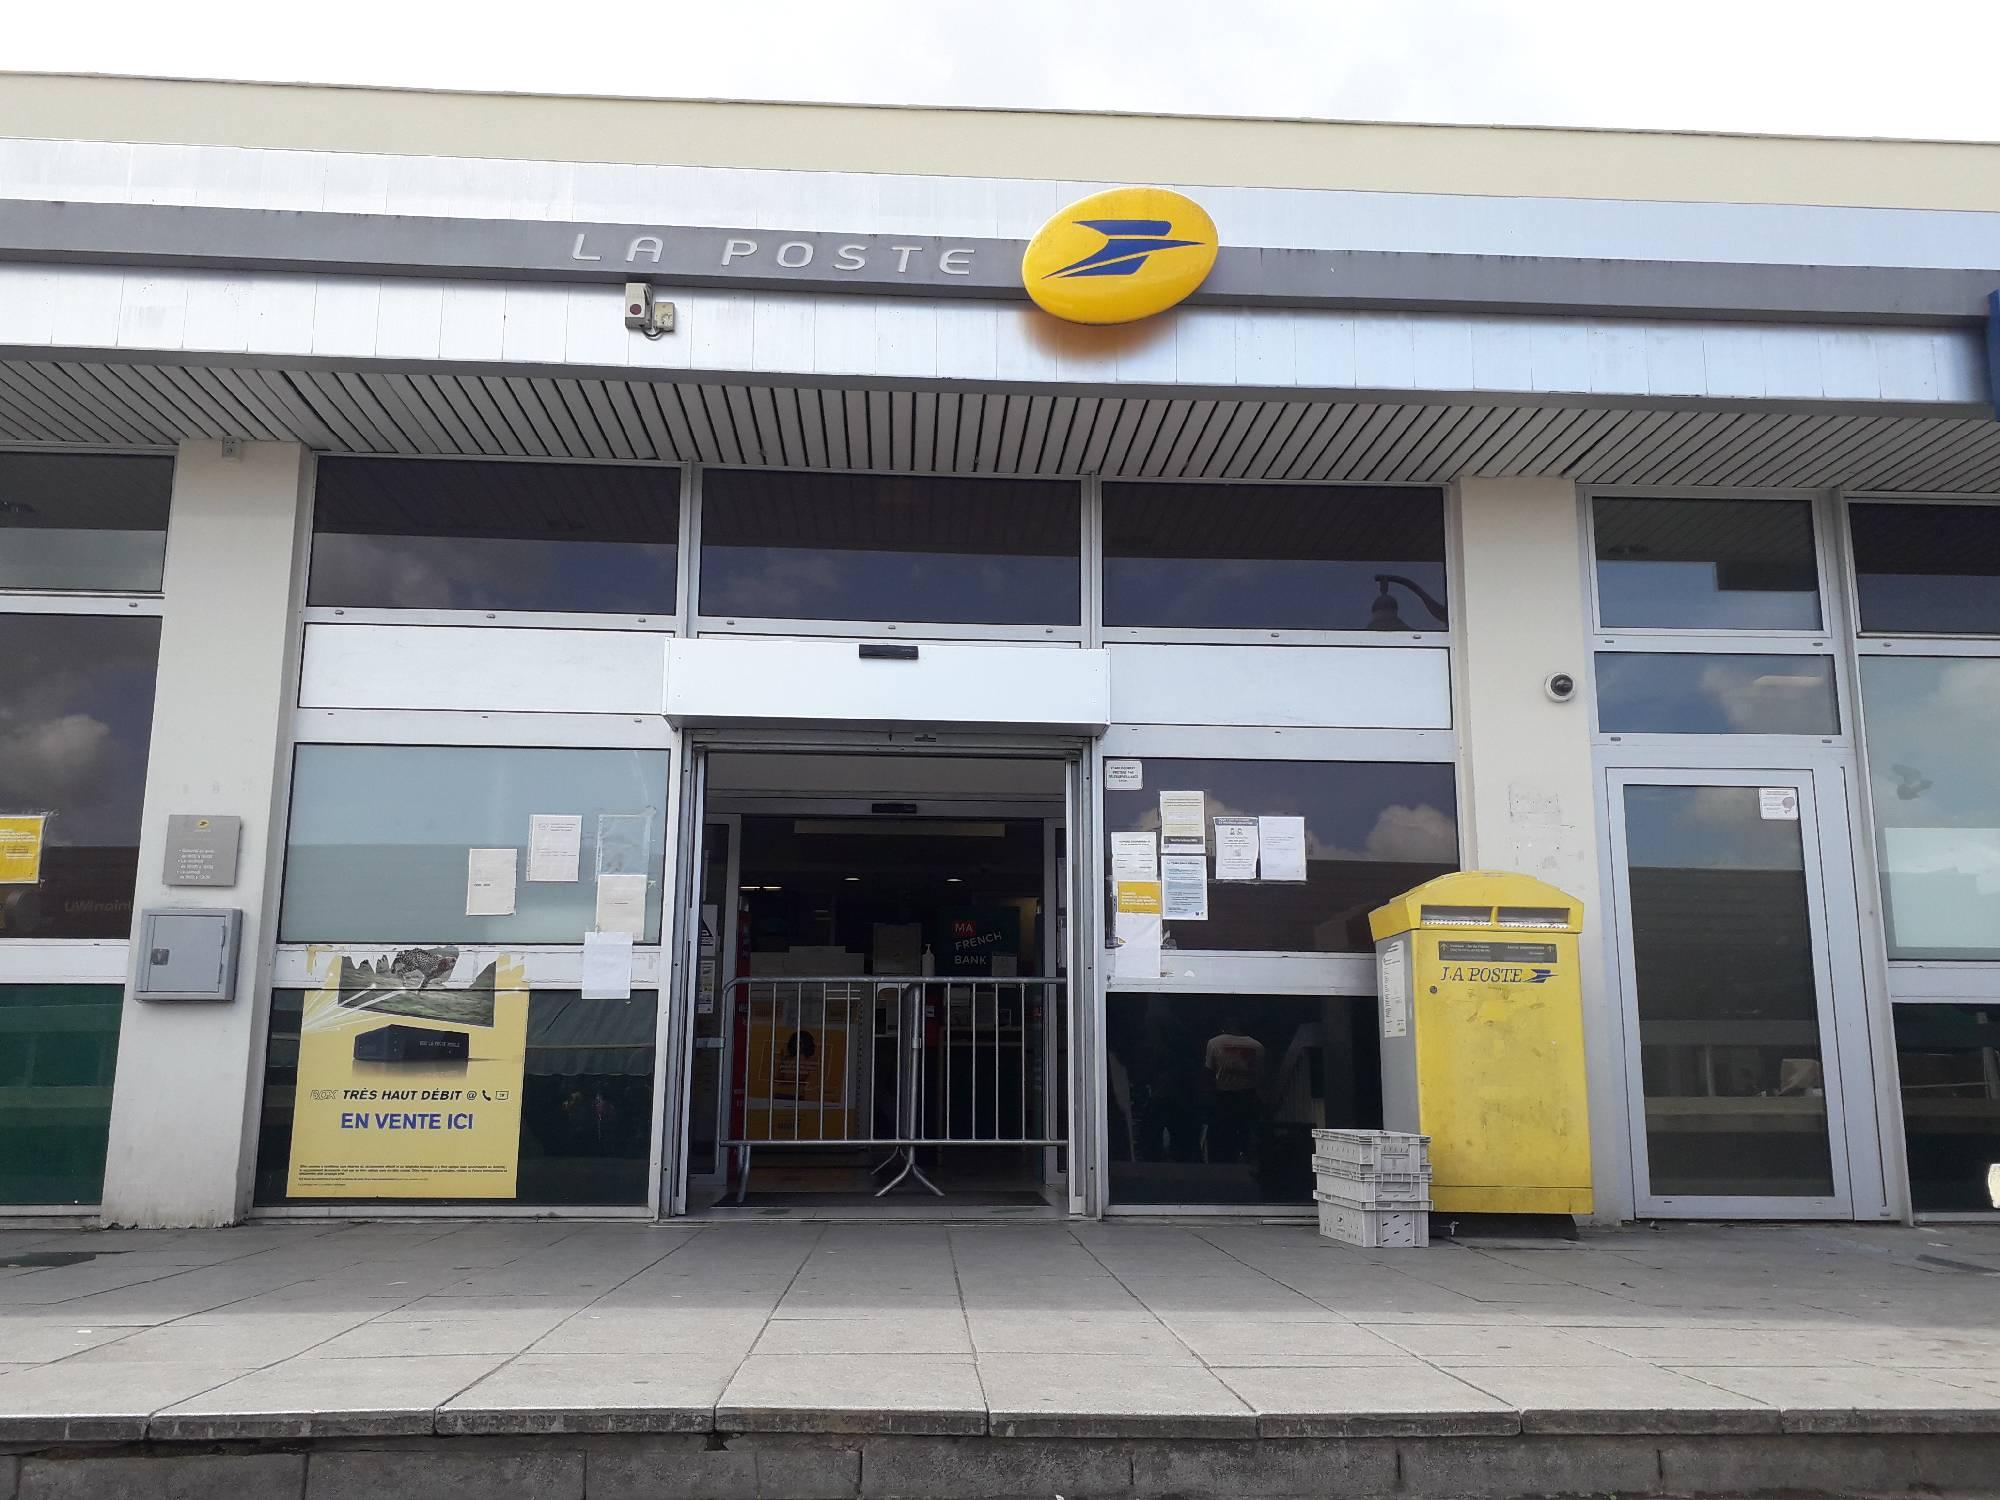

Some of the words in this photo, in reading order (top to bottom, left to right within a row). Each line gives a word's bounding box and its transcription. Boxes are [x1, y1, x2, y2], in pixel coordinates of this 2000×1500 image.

[572, 233, 664, 263] LA
[721, 239, 976, 275] POSTE
[954, 923, 973, 933] MA
[955, 931, 1002, 951] FRENCH
[954, 955, 987, 965] BANK
[1440, 966, 1464, 981] LA
[1468, 967, 1523, 982] POSTE
[310, 1090, 339, 1101] BOX
[381, 1090, 418, 1100] HAUT
[421, 1087, 462, 1100] DÉBIT
[341, 1113, 369, 1128] EN
[375, 1113, 441, 1129] VENTE
[447, 1113, 473, 1129] ICI
